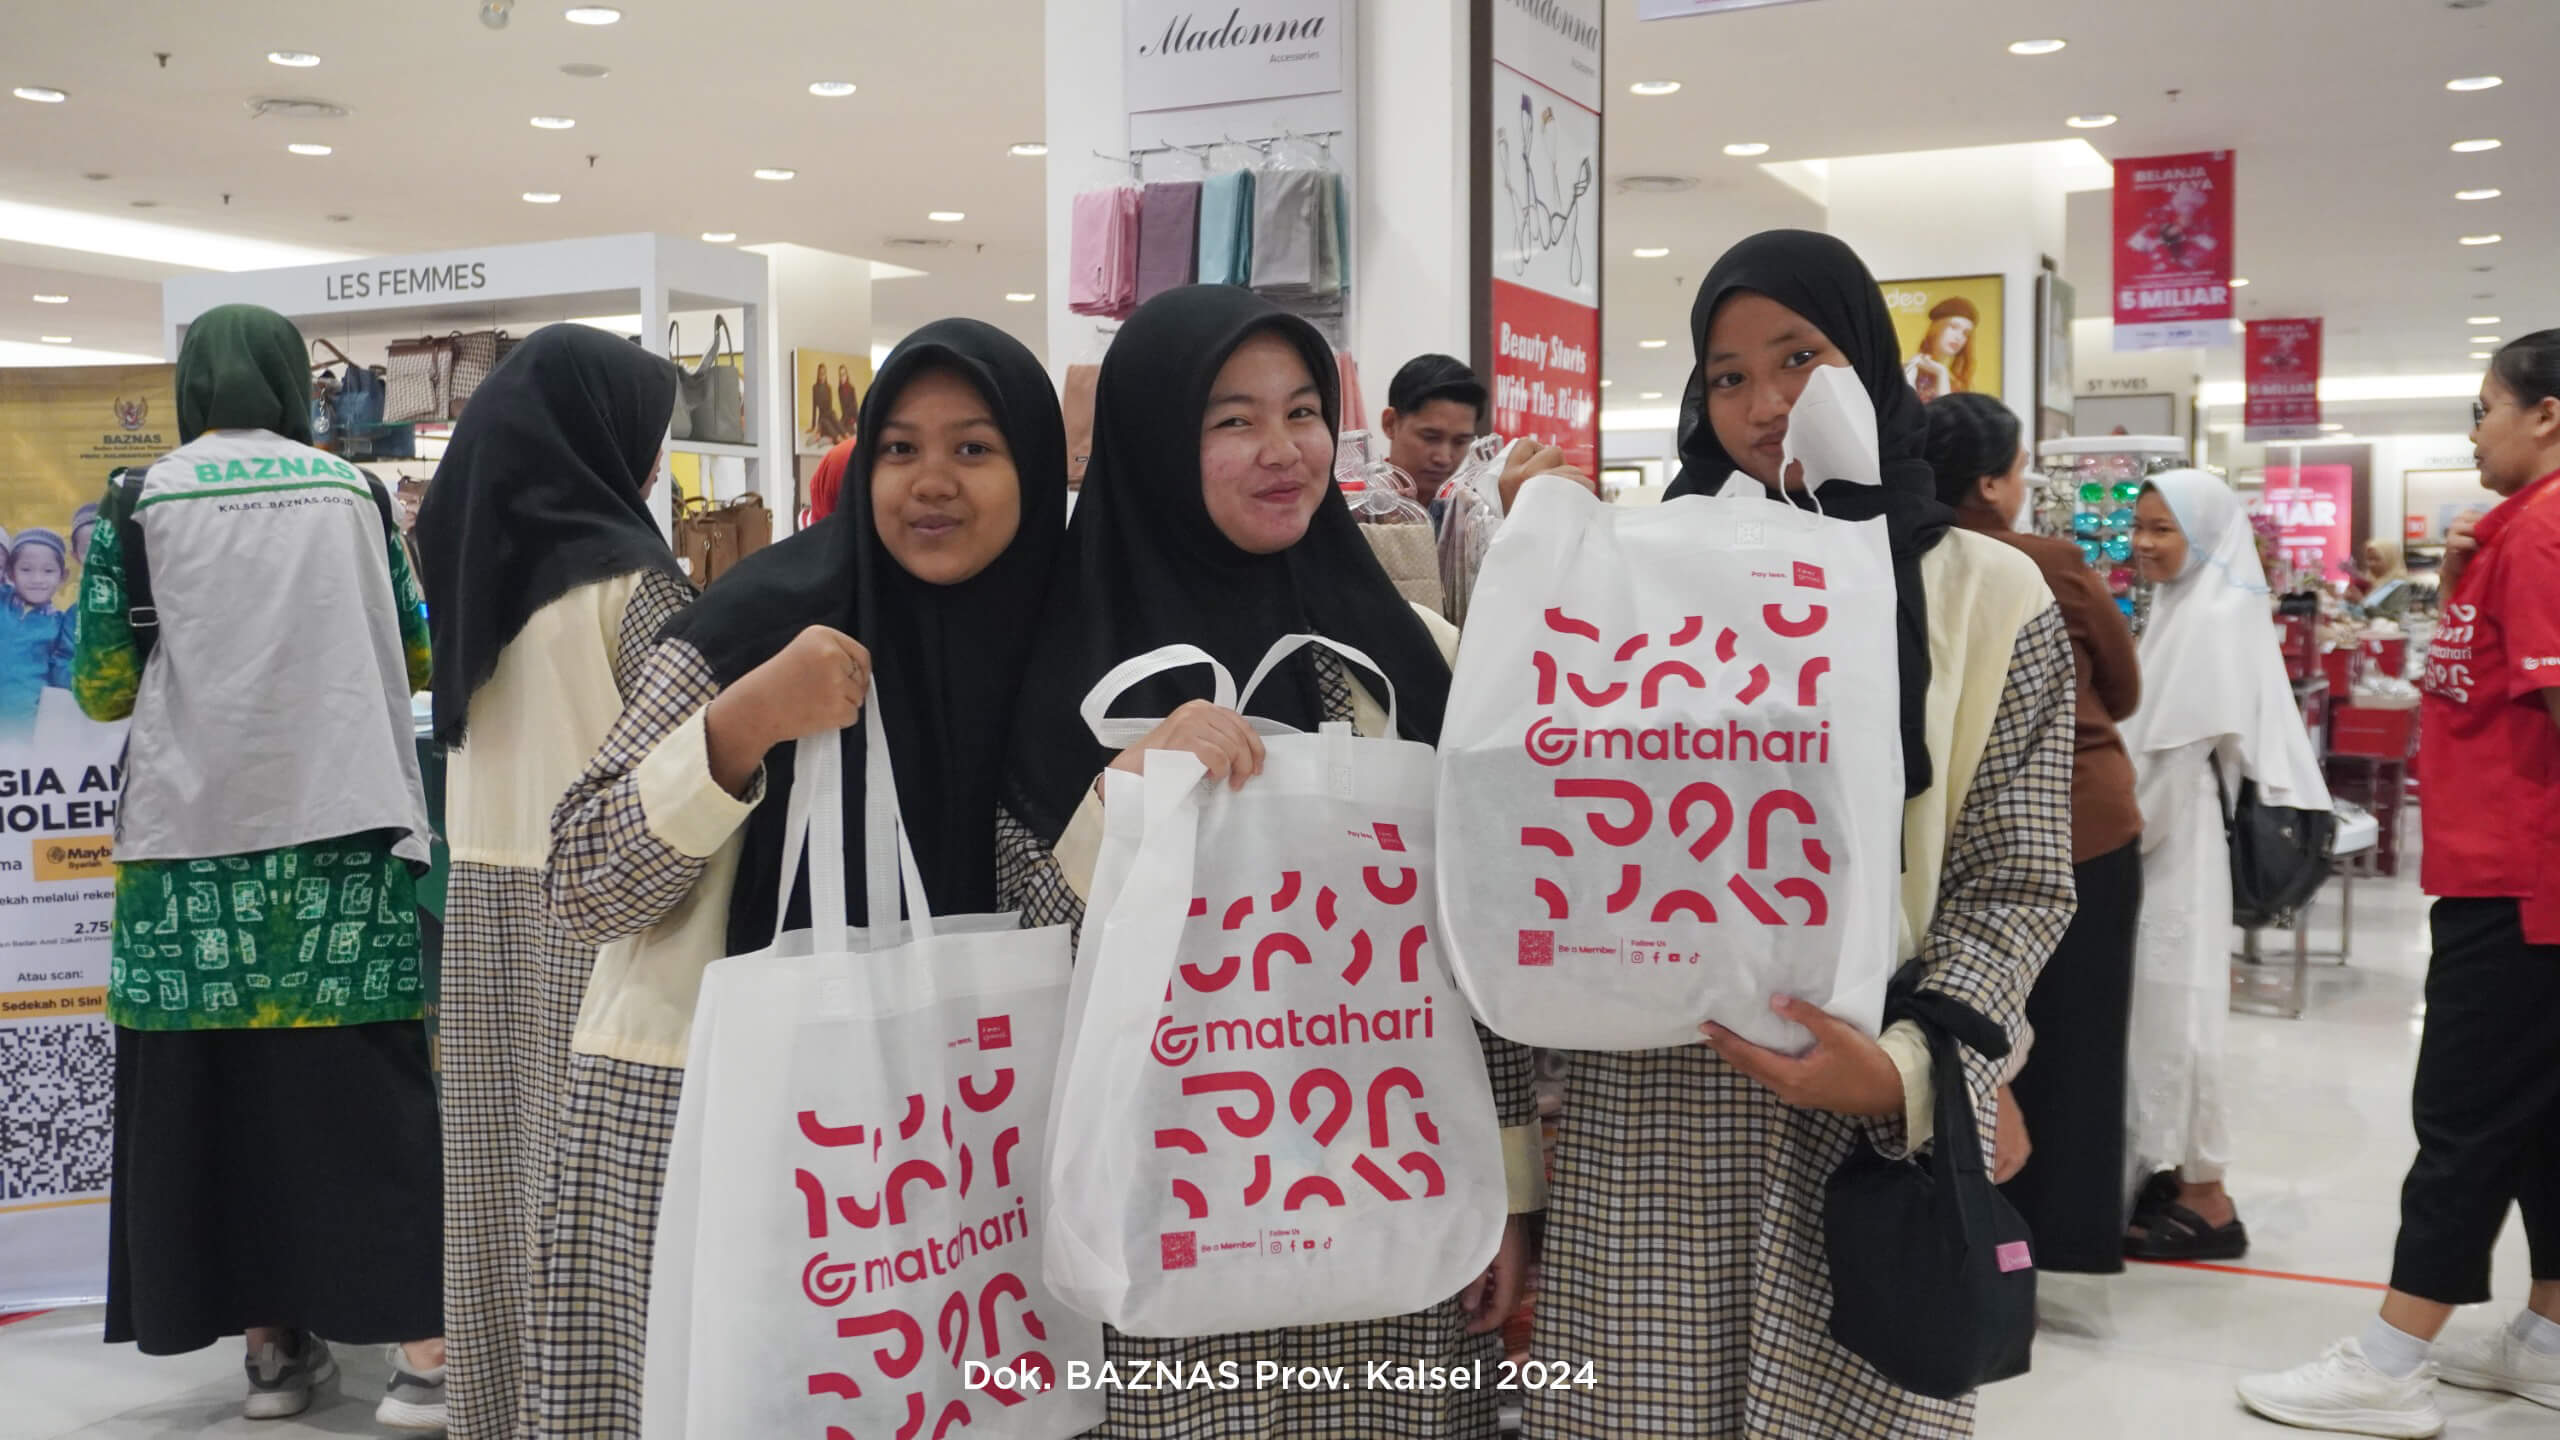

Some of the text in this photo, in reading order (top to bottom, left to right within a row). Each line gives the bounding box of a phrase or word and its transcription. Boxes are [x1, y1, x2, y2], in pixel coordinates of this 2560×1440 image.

[1139, 7, 1325, 57] Madonna
[1269, 50, 1320, 63] Accessories
[2134, 167, 2207, 183] BELANJA
[326, 262, 486, 301] LES FEMMES
[2120, 286, 2228, 310] 5 MILIAR
[1500, 321, 1586, 374] Beauty Starts
[1497, 374, 1528, 413] With
[1531, 380, 1555, 417] The
[103, 433, 161, 445] BAZNAS
[194, 456, 357, 483] BAZNAS
[1584, 719, 1831, 763] matahari
[0, 768, 66, 798] GIA
[67, 846, 112, 860] Mayb
[32, 892, 79, 904] melalui
[1579, 946, 1617, 954] Member
[1631, 939, 1655, 947] Follow
[17, 970, 84, 982] Atau scan:
[2, 996, 102, 1012] Sedekah Di Sini
[1205, 995, 1434, 1053] matahari
[864, 1196, 1029, 1293] matahari
[1221, 1241, 1257, 1250] Member
